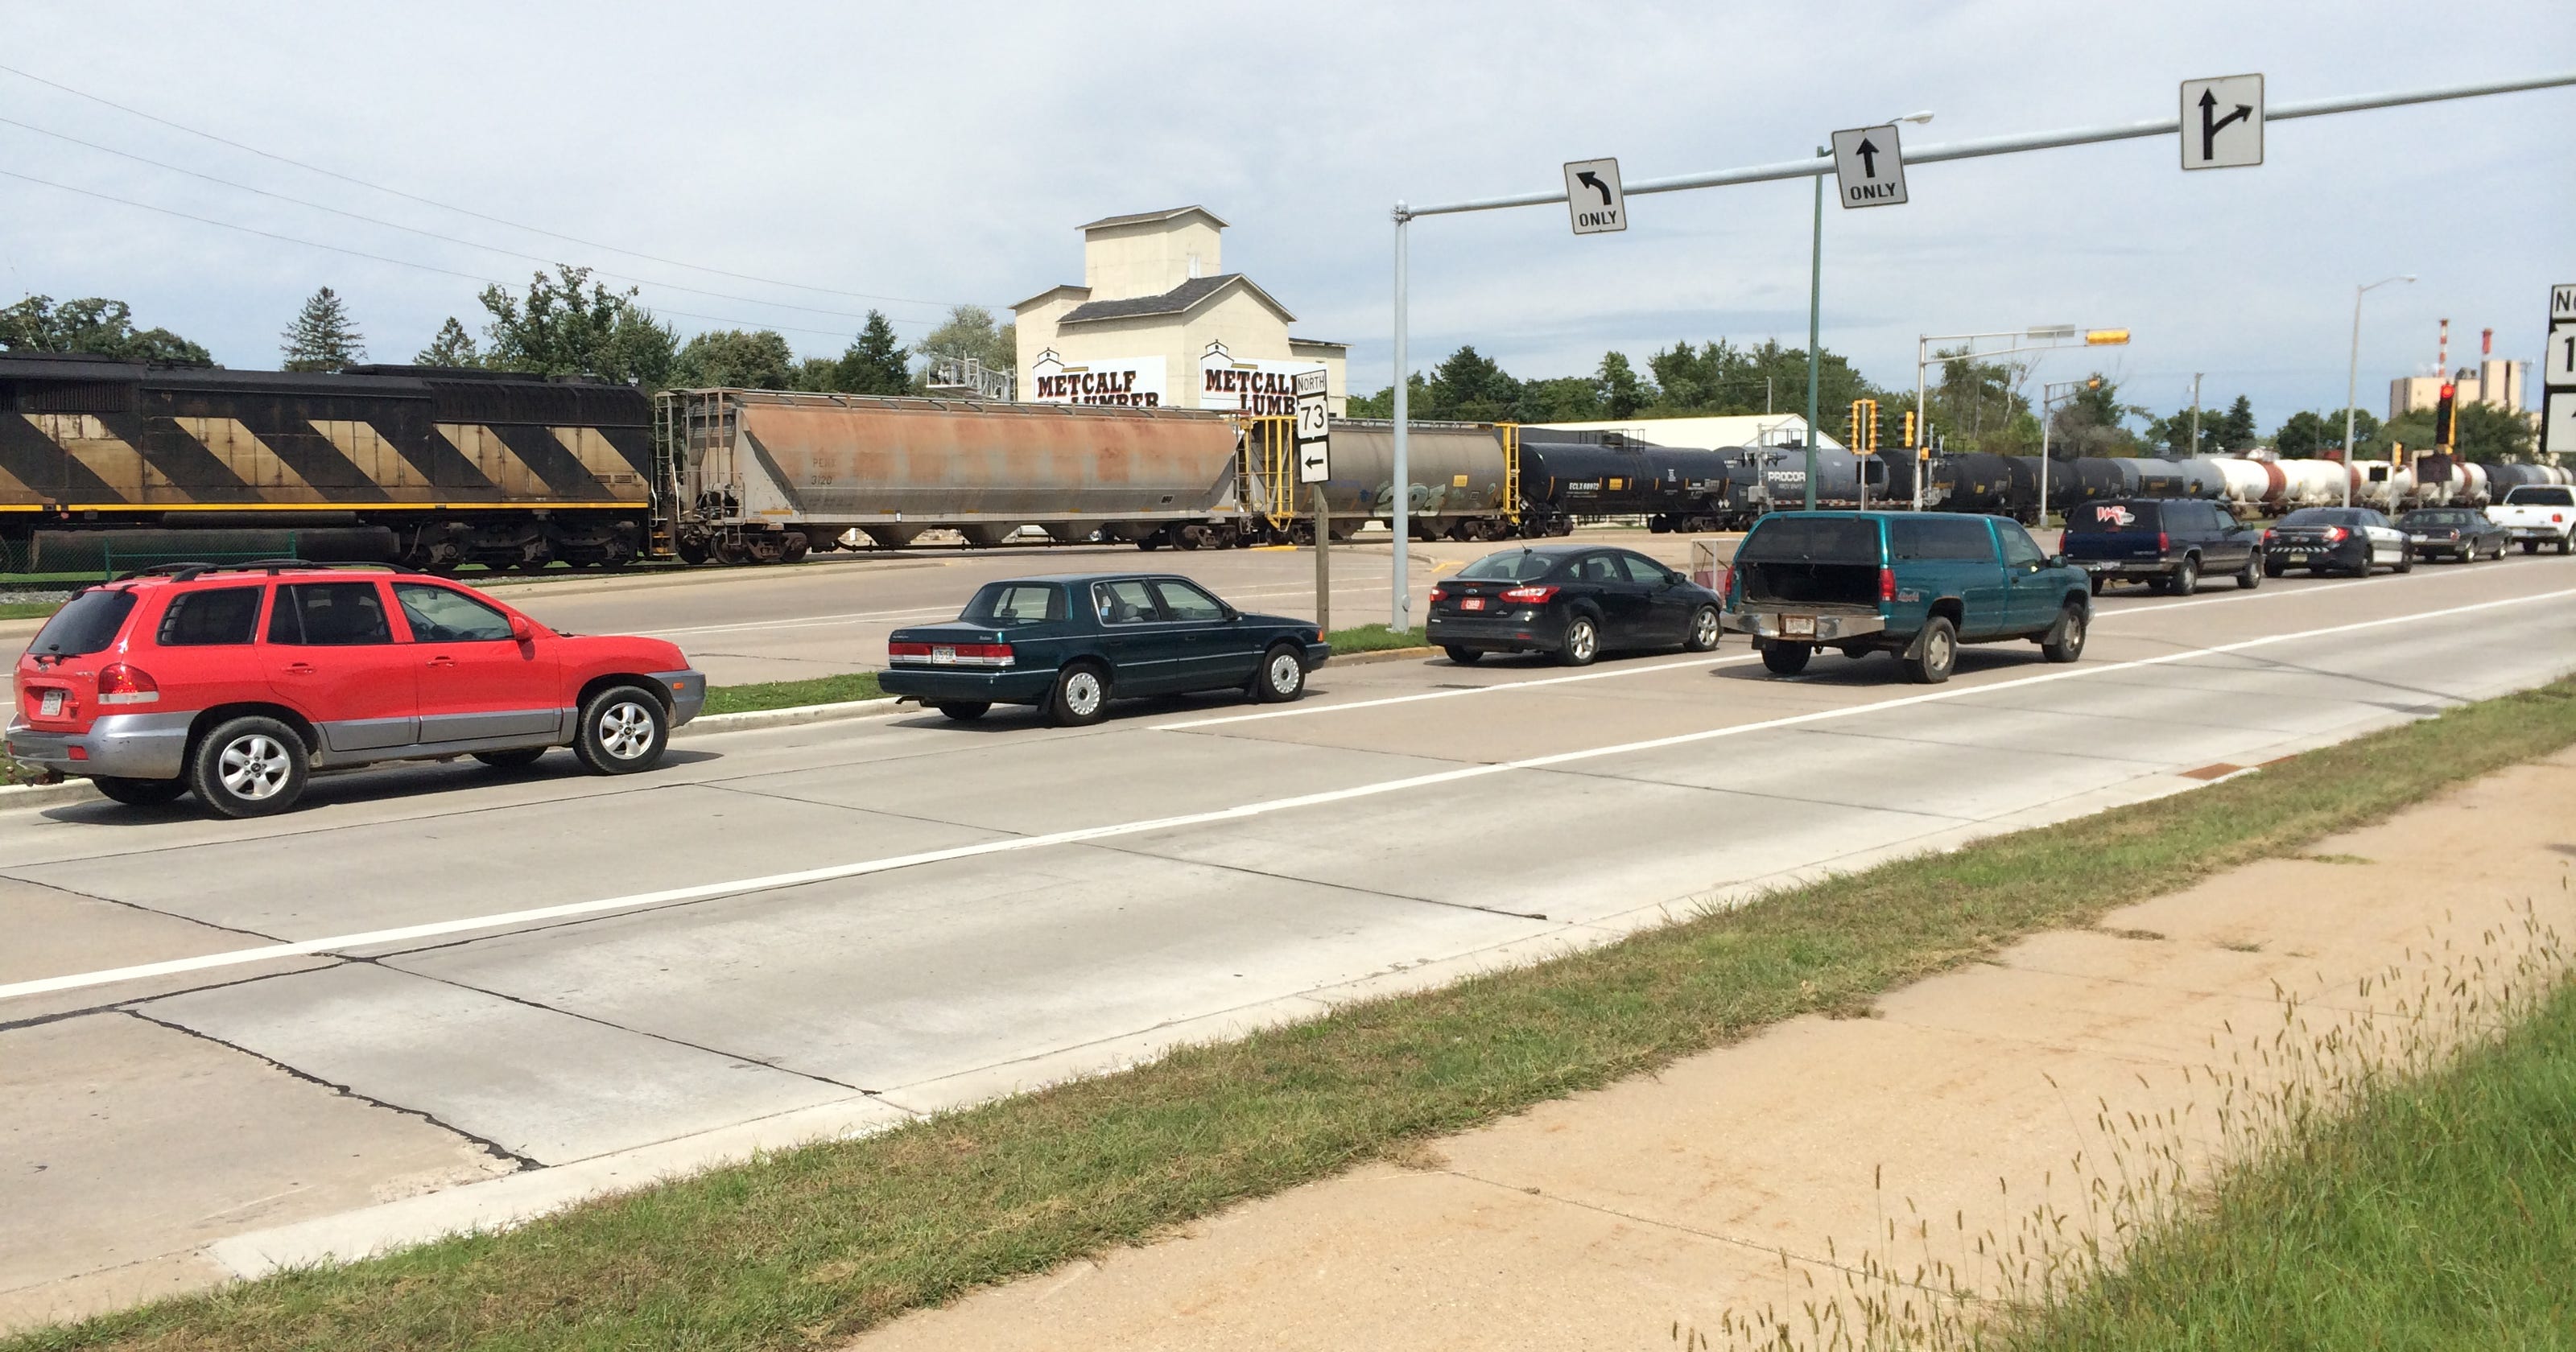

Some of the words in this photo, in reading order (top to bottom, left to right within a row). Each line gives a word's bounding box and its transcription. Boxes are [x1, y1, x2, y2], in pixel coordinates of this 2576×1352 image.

[1850, 182, 1896, 200] ONLY
[1579, 210, 1616, 227] ONLY
[1038, 370, 1136, 398] METCALF
[1298, 375, 1325, 392] NORTH
[1240, 393, 1297, 416] LUMB
[1300, 404, 1325, 431] 73
[811, 475, 832, 485] 3120
[1768, 472, 1806, 482] PROCOR
